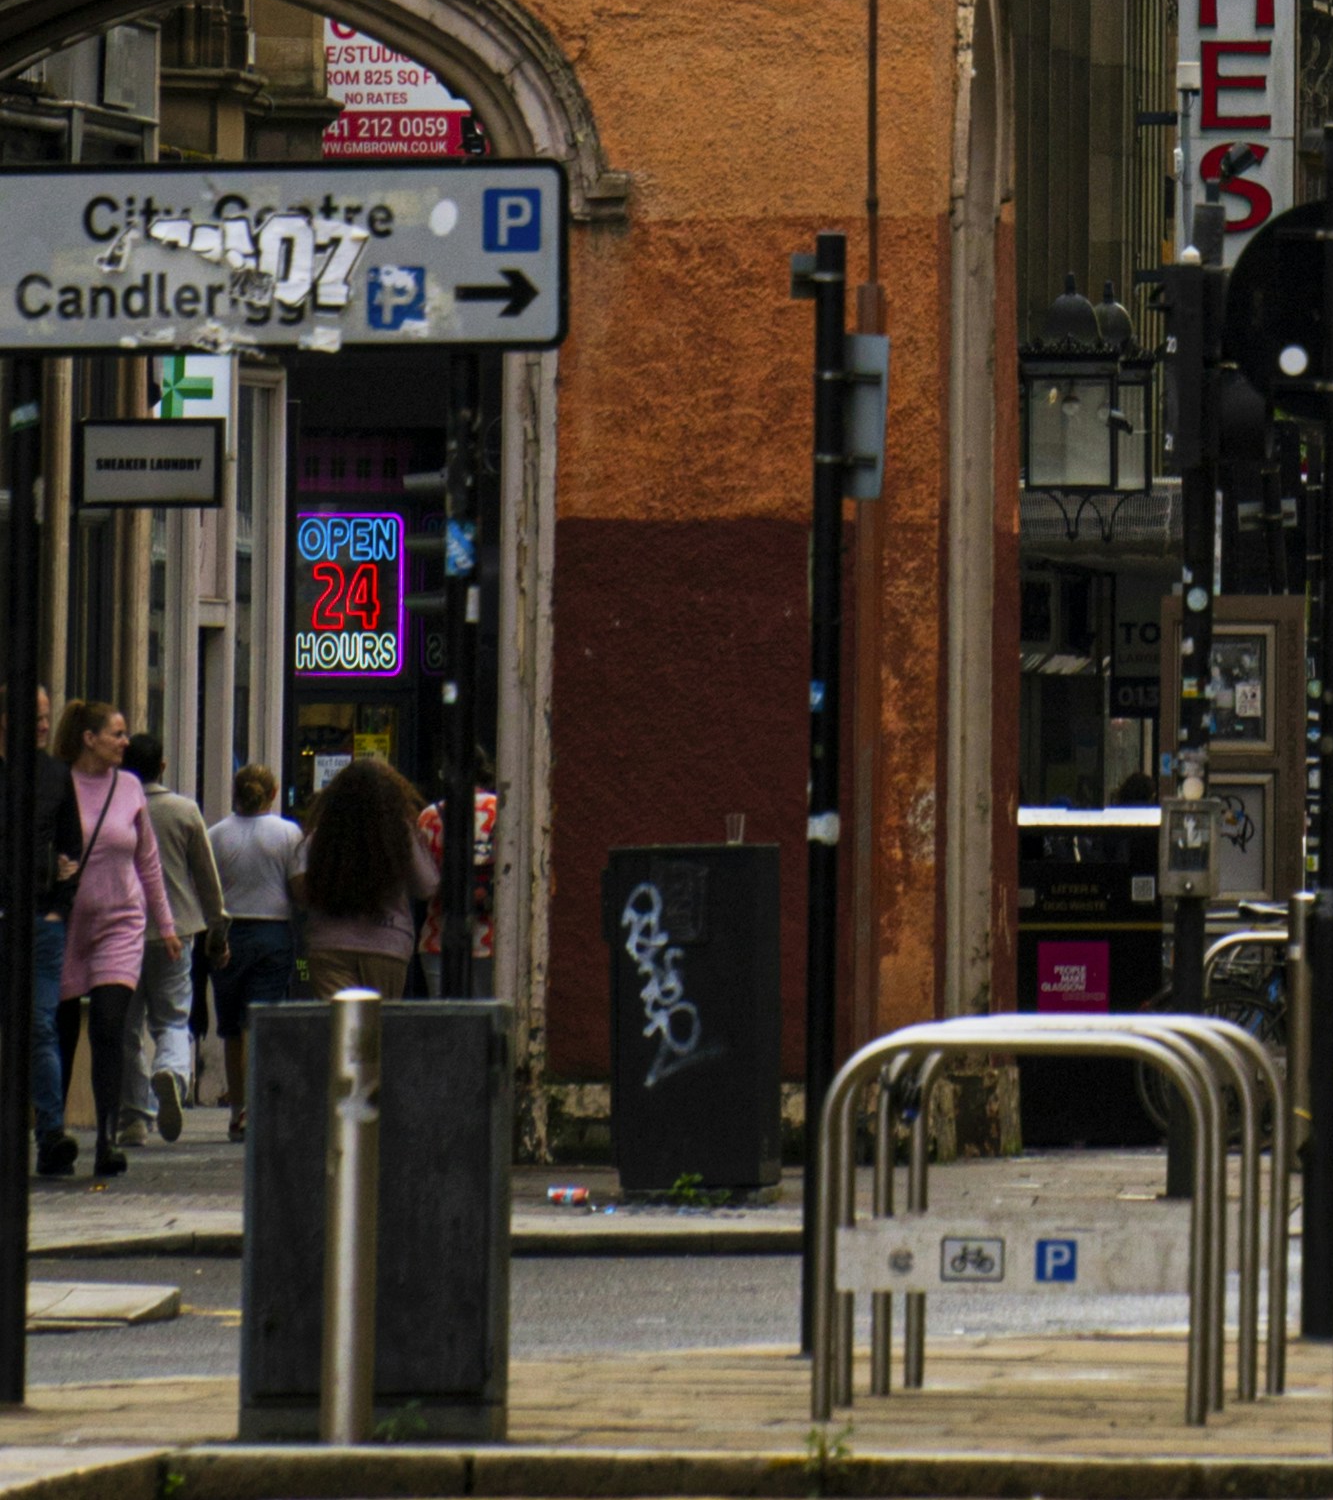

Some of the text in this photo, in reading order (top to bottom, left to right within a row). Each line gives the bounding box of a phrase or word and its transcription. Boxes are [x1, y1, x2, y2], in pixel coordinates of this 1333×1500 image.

[327, 70, 440, 87] ROM 825 SQ F
[344, 92, 408, 105] NO RATES
[358, 118, 393, 137] 212
[399, 117, 448, 137] 0059
[322, 141, 448, 154] W.GMBROWN.CO.UK
[297, 517, 398, 562] OPEN
[311, 561, 382, 631] 24
[1119, 621, 1161, 645] TO
[295, 632, 398, 670] HOURS
